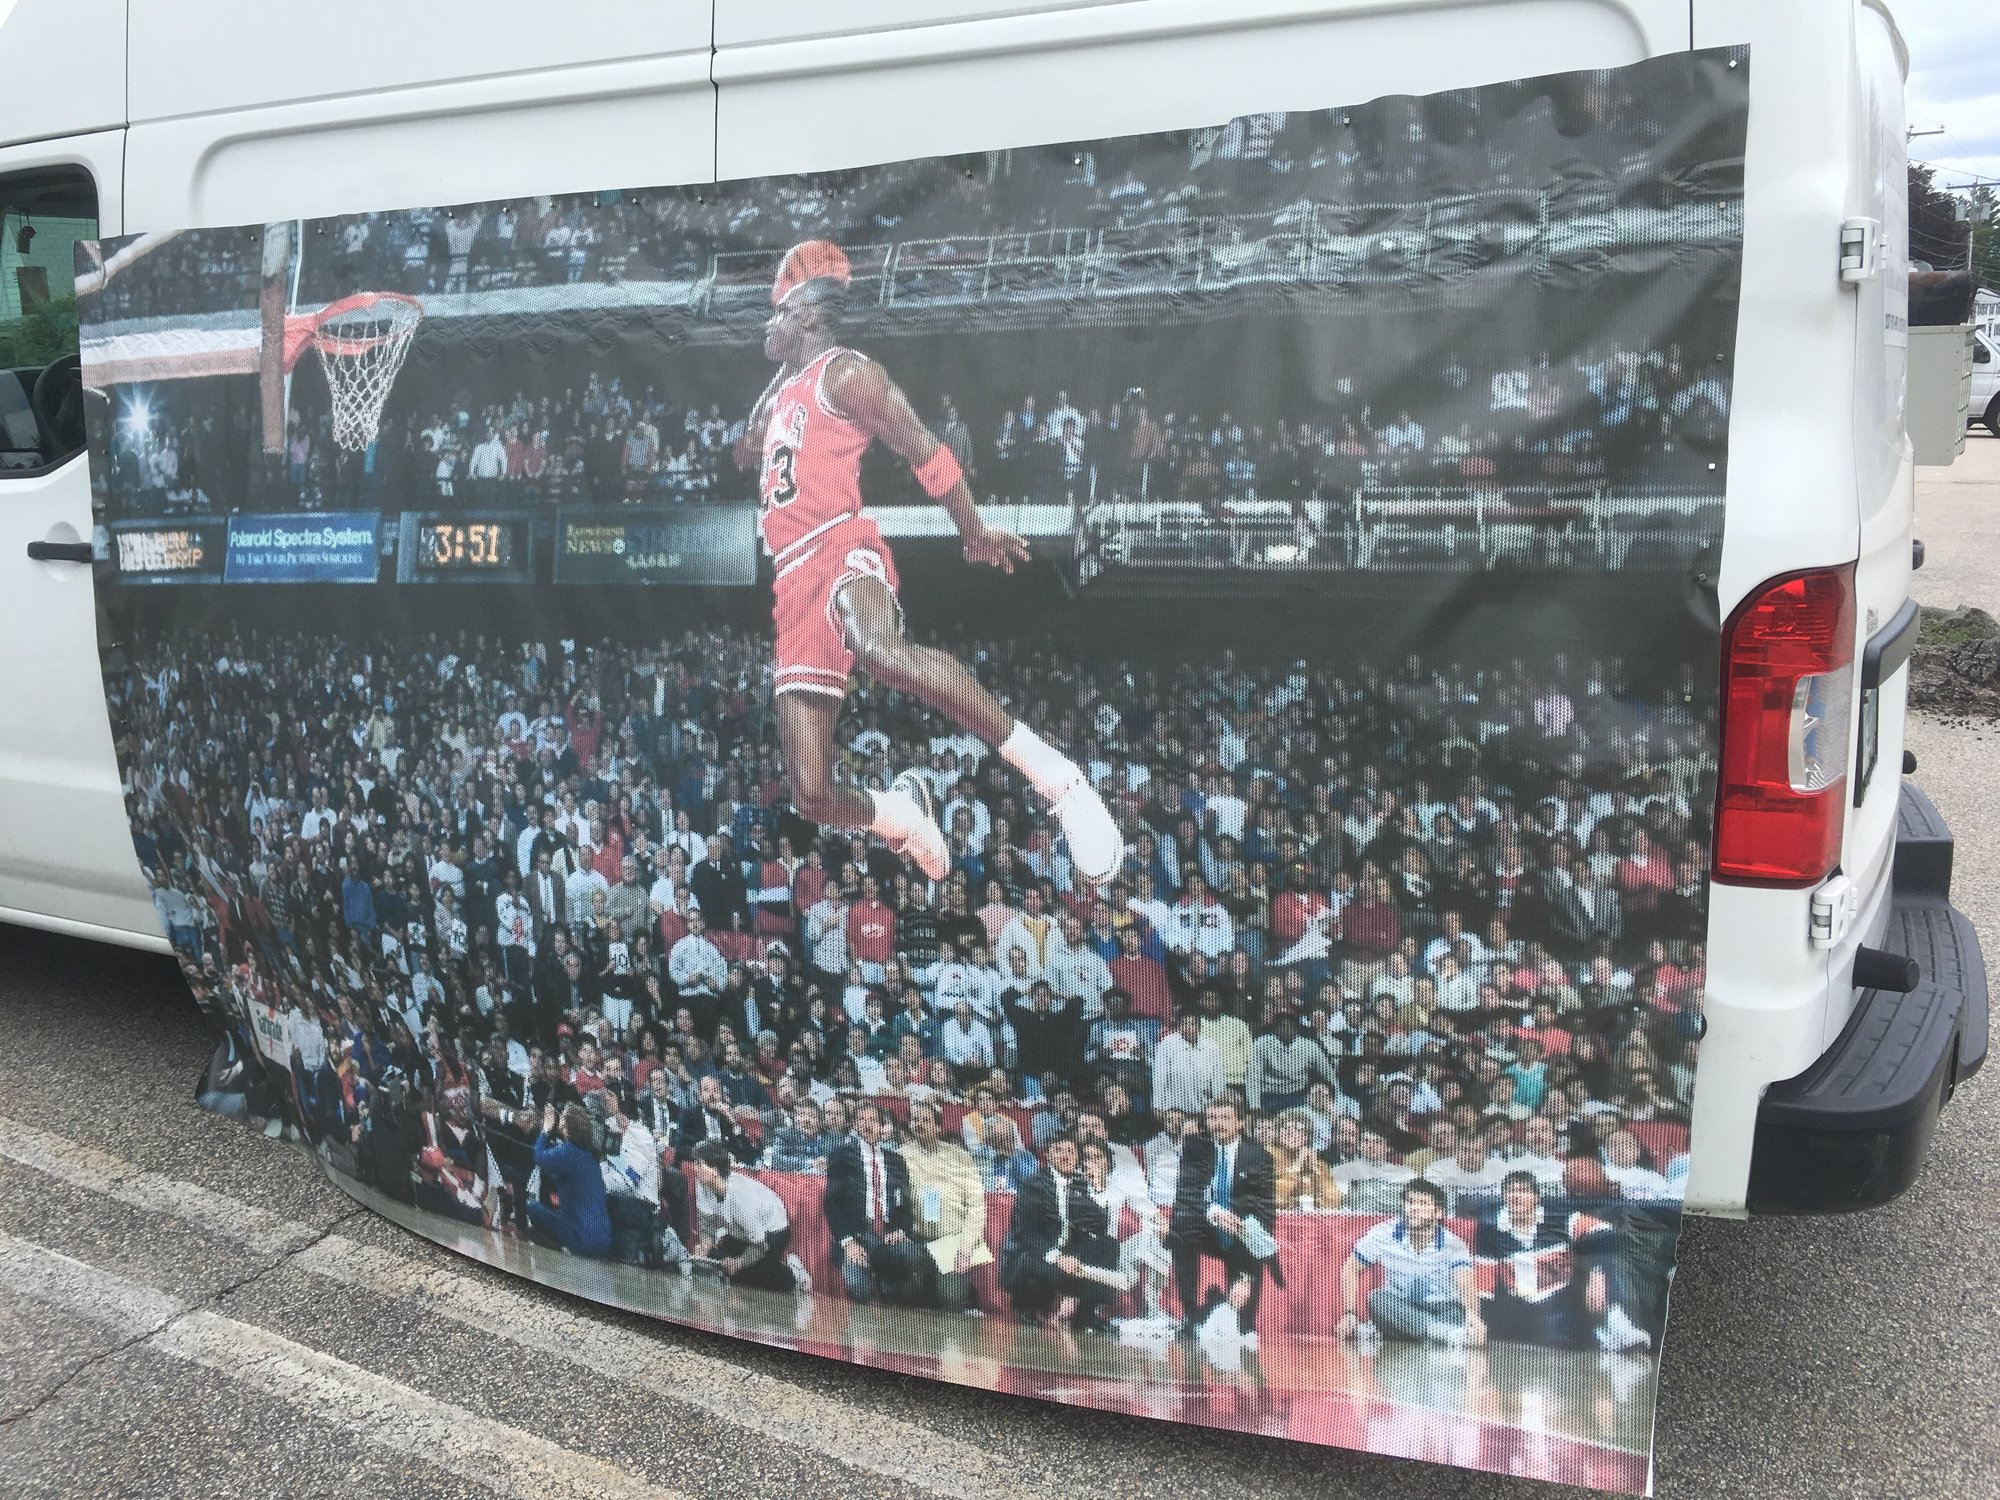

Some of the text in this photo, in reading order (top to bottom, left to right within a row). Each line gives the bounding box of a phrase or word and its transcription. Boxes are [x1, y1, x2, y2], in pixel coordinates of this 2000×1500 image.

[230, 530, 272, 548] Polaroid
[274, 527, 321, 549] Spectra
[435, 525, 498, 563] 3:51
